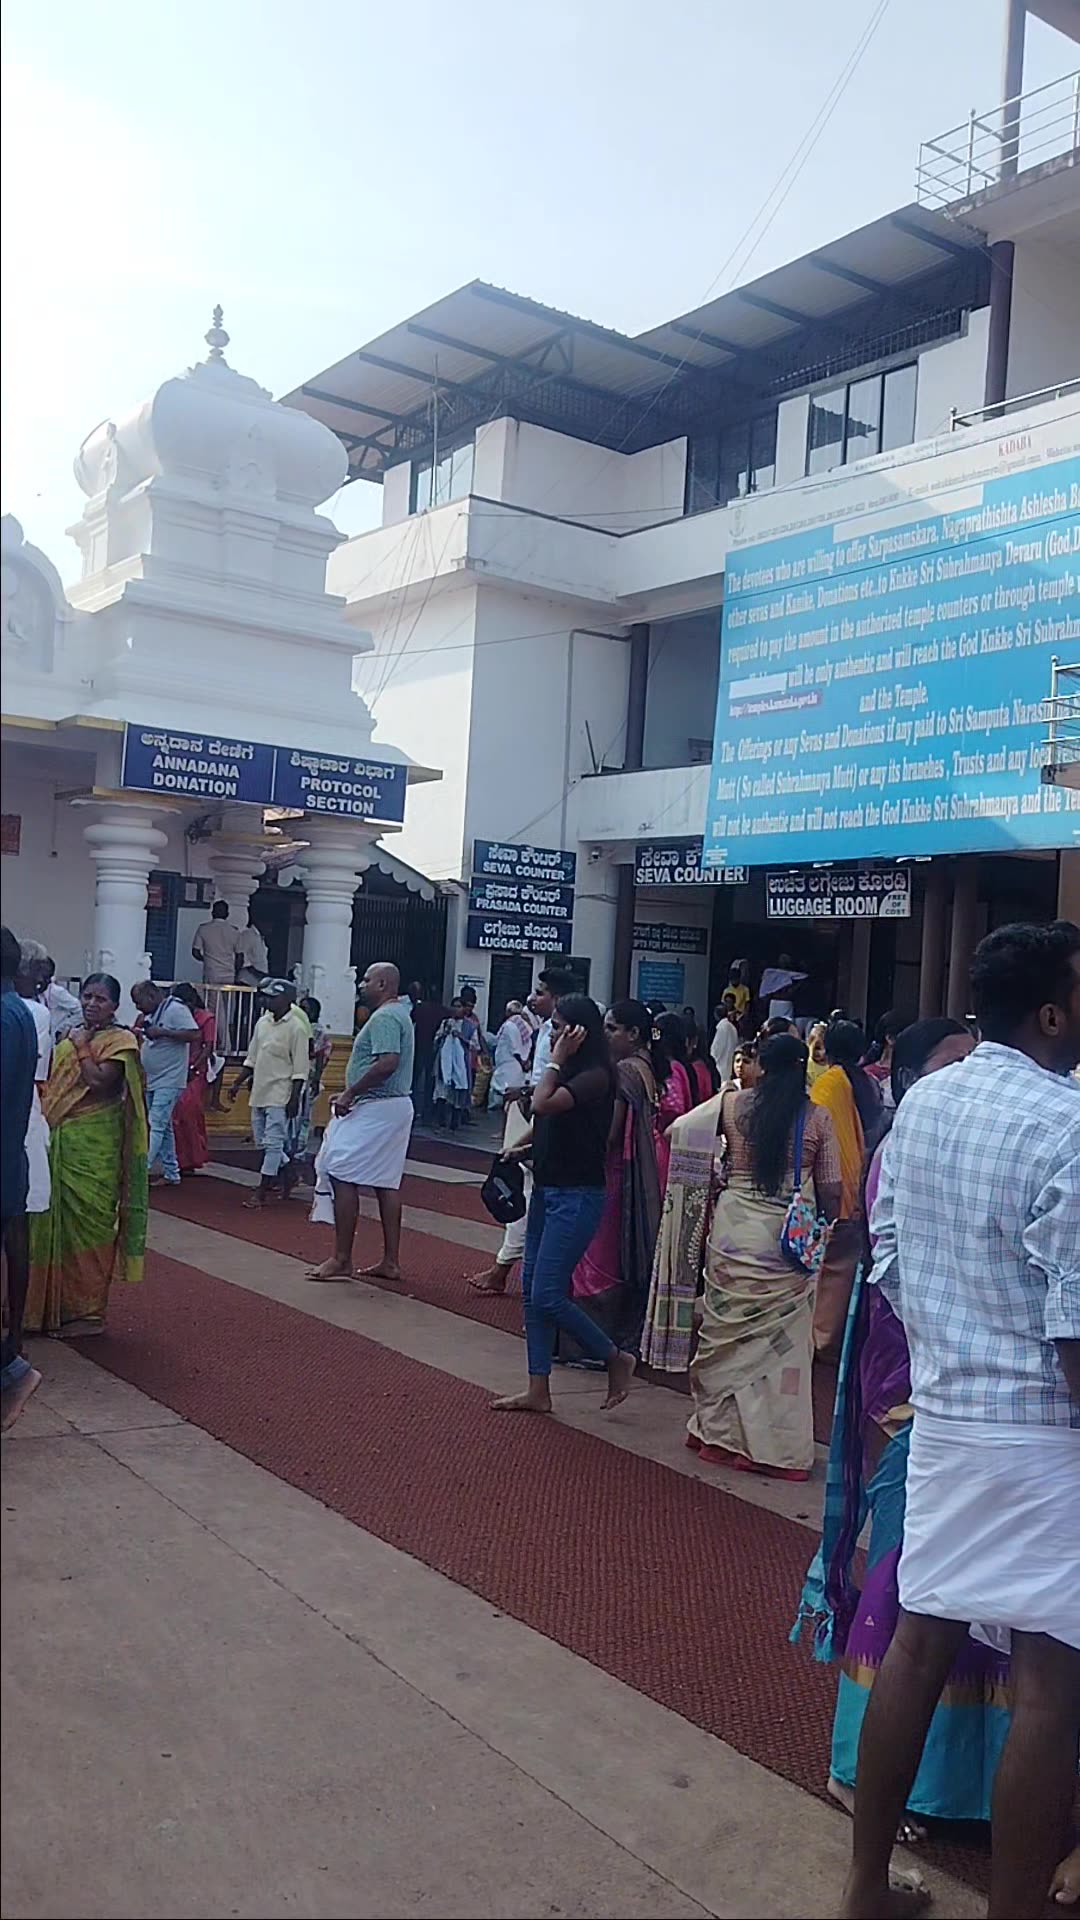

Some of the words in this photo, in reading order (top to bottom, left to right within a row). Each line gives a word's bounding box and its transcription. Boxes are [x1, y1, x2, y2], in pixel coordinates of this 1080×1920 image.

[728, 574, 741, 594] The
[743, 564, 774, 590] devotees
[775, 560, 791, 582] who
[792, 559, 806, 578] are
[807, 550, 833, 575] willing
[836, 546, 845, 565] to
[846, 539, 867, 561] offer
[942, 501, 1017, 541] Nagaprathishta
[1020, 487, 1067, 520] Ashlesha
[728, 604, 746, 629] other
[748, 606, 768, 625] sevas
[770, 596, 784, 618] and
[817, 582, 858, 608] Donations
[889, 567, 918, 591] Kukke
[920, 561, 934, 585] Sri
[937, 550, 1002, 576] Subrahmanya
[1005, 540, 1042, 566] Devaru
[728, 636, 759, 668] required
[760, 636, 768, 657] to
[769, 637, 782, 661] pay
[784, 631, 797, 652] the
[798, 626, 828, 649] amount
[830, 619, 839, 642] in
[840, 617, 854, 640] the
[856, 606, 902, 638] authorized
[904, 600, 934, 631] temple
[937, 593, 979, 621] counters
[981, 592, 993, 612] or
[995, 579, 1035, 611] through
[1038, 570, 1075, 605] temple
[788, 664, 803, 688] will
[804, 662, 815, 684] be
[815, 659, 833, 687] only
[834, 653, 875, 680] authentic
[876, 646, 893, 672] and
[895, 643, 912, 668] will
[912, 639, 939, 665] reach
[941, 635, 957, 660] the
[959, 630, 979, 657] God
[980, 626, 1013, 653] Kukke
[1015, 621, 1032, 648] Sri
[859, 688, 876, 712] and
[878, 686, 893, 709] the
[895, 681, 928, 711] Temple.
[721, 741, 735, 763] The
[738, 736, 773, 764] Offerings
[773, 739, 783, 756] or
[783, 737, 799, 760] any
[799, 729, 823, 753] Sevas
[824, 725, 841, 749] and
[842, 720, 885, 747] Donations
[887, 716, 896, 742] if
[895, 720, 911, 746] any
[913, 712, 935, 745] paid
[937, 714, 947, 735] to
[949, 706, 964, 734] Sri
[966, 702, 1010, 736] Samputa
[141, 732, 203, 755] ಅನ್ನದಾನ
[208, 741, 254, 760] ದೇಣಿಗೆ
[152, 755, 240, 779] ANNADANA
[354, 761, 394, 781] ವಿಭಾಗ
[717, 777, 736, 800] Mutt
[752, 772, 775, 797] called
[777, 768, 830, 796] Subrahmanya
[858, 767, 869, 786] or
[870, 765, 887, 791] any
[888, 760, 901, 783] its
[902, 753, 945, 781] branches
[952, 750, 985, 776] Trusts
[986, 745, 1007, 773] and
[1008, 749, 1029, 777] any
[153, 773, 237, 796] DONATION
[301, 776, 381, 799] PROTOCOL
[306, 794, 374, 815] SECTION
[713, 815, 727, 837] will
[727, 815, 740, 836] not
[741, 813, 751, 835] be
[751, 811, 789, 835] authentic
[790, 808, 805, 832] and
[807, 806, 823, 830] will
[823, 806, 838, 830] not
[839, 803, 863, 828] reach
[865, 801, 880, 827] the
[882, 799, 900, 825] God
[901, 797, 931, 824] Kukke
[933, 795, 949, 821] Sri
[951, 792, 1019, 823] Subrahmanya
[1021, 786, 1041, 813] and
[1043, 784, 1061, 813] the
[488, 844, 518, 862] ಸೇವಾ
[641, 847, 679, 867] ಸೇವಾ
[483, 861, 511, 876] SEVA
[515, 865, 565, 881] COUNTER
[636, 867, 671, 883] SEVA
[674, 866, 744, 882] COUNTER
[485, 881, 518, 900] ಪ್ರಸಾದ
[476, 898, 522, 913] PRASADA
[523, 902, 567, 917] COUNTER
[769, 897, 832, 915] LUGGAGE
[836, 896, 877, 915] ROOM
[479, 936, 529, 950] LUGGAGE
[533, 940, 563, 952] ROOM
